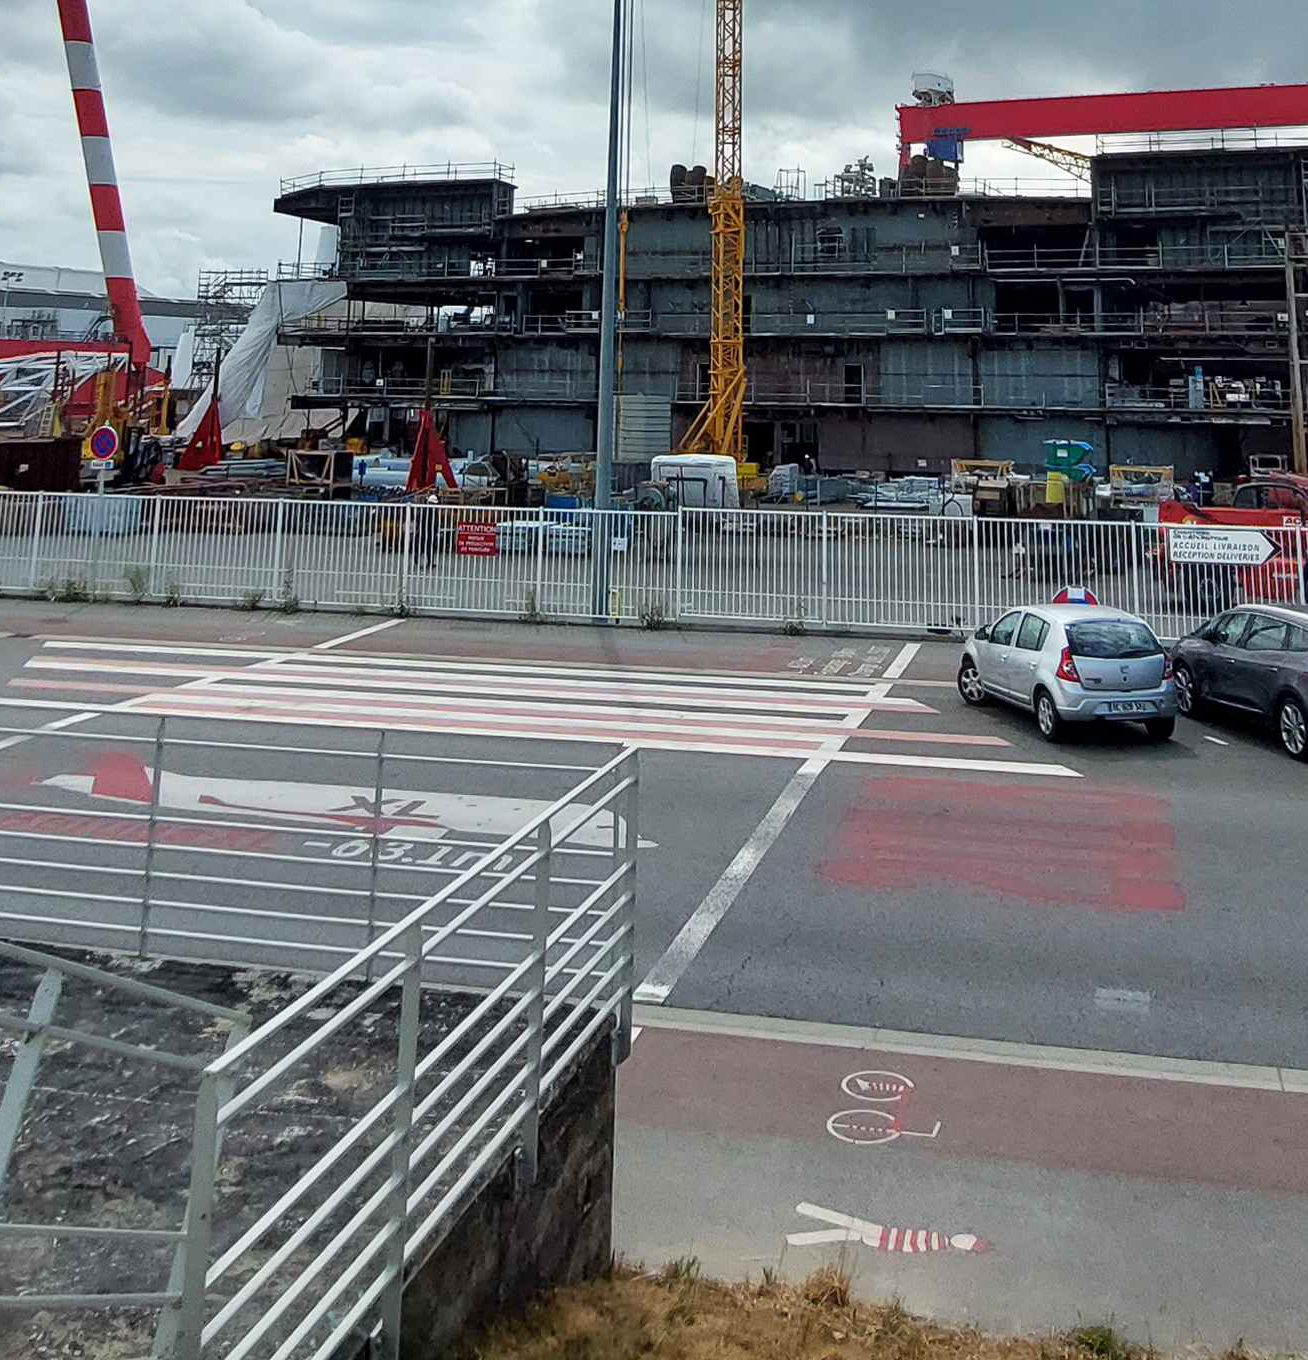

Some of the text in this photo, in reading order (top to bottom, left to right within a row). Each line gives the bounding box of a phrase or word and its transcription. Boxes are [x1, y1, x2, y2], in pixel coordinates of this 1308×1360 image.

[1173, 542, 1260, 552] ACCUEIL LIVRAISON
[1216, 552, 1260, 561] DELIVERIES
[327, 795, 440, 820] XL
